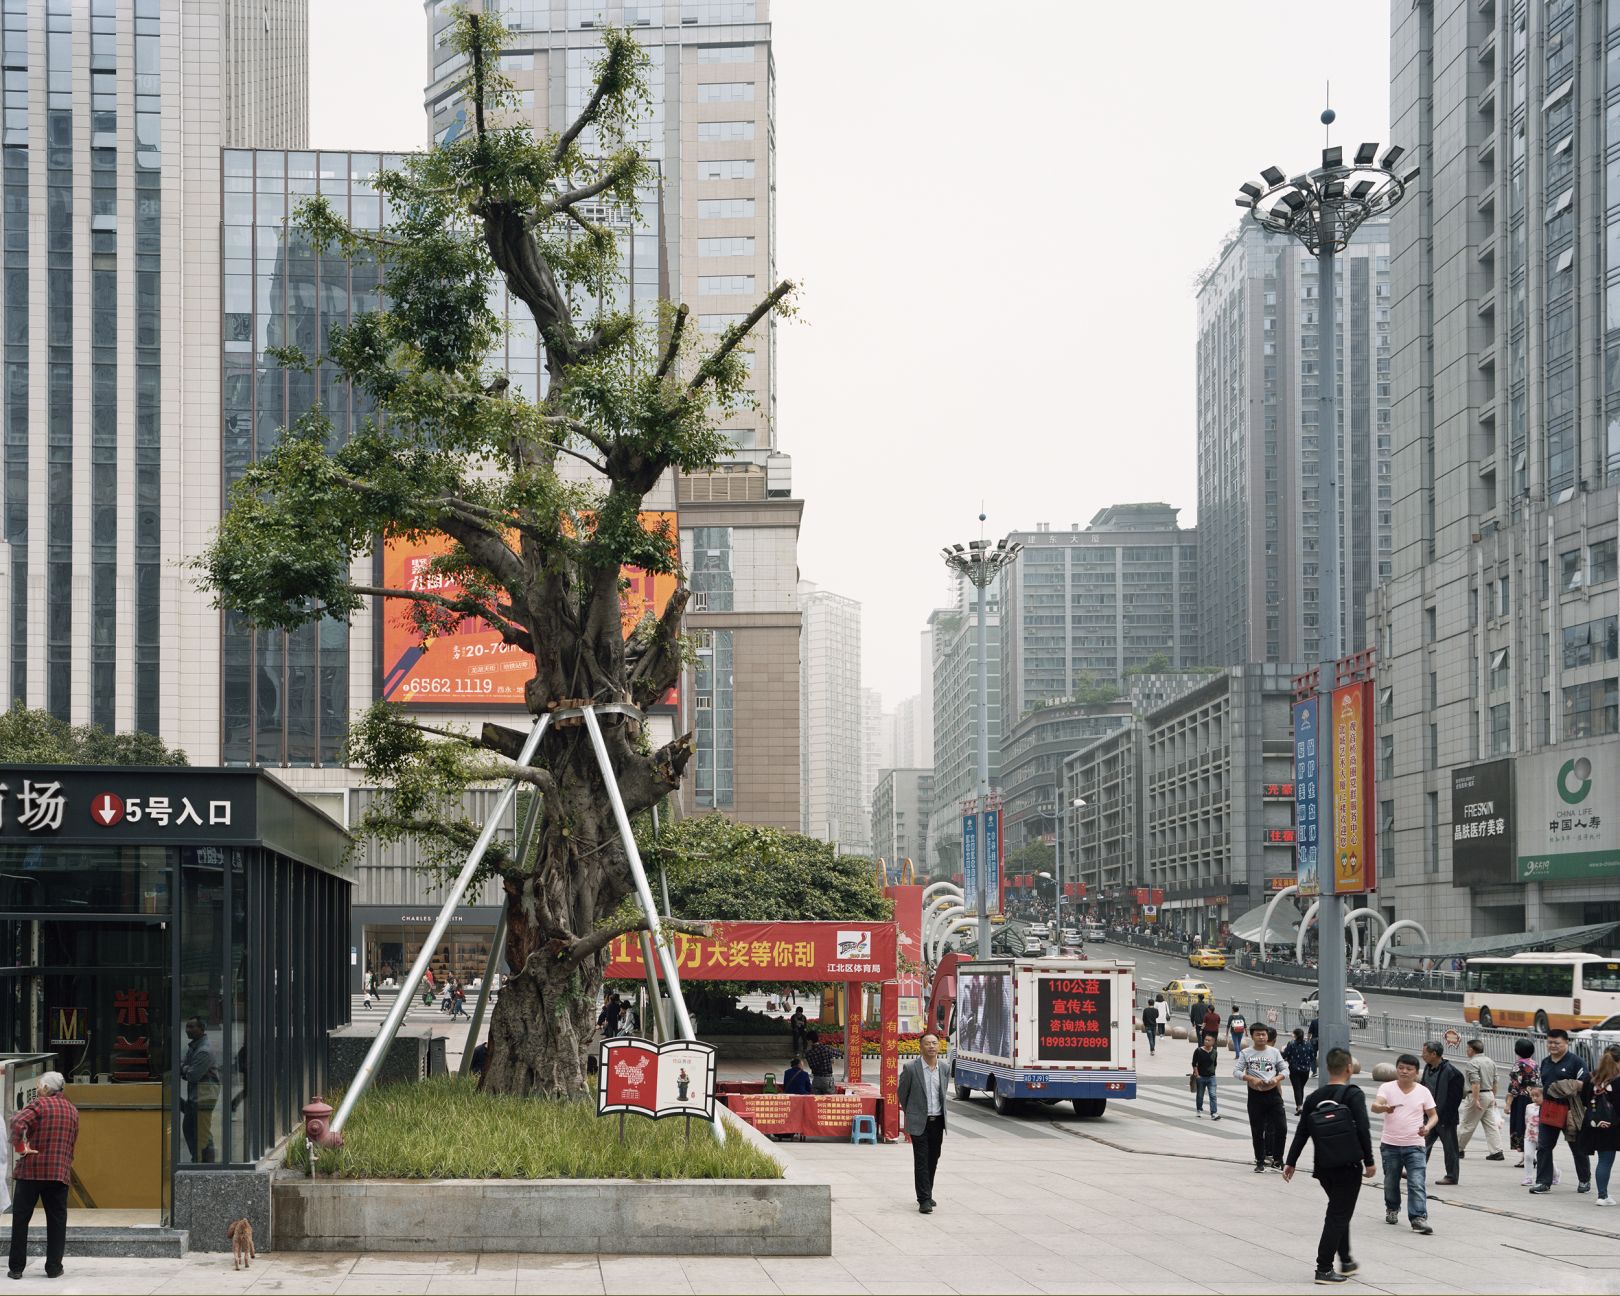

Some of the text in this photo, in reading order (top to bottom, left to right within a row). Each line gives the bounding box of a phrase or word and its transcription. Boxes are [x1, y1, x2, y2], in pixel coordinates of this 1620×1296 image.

[410, 678, 493, 693] 6562 1119
[0, 779, 66, 831] 场
[125, 796, 232, 826] 5号入口
[1464, 801, 1494, 818] FRESKIN
[1556, 807, 1593, 818] CHINA LIFE
[1454, 817, 1505, 841] 晶肤医疗美容
[1549, 815, 1601, 833] 中国人寿
[826, 963, 881, 973] 江北区体育局
[1048, 979, 1100, 994] 110公益
[1052, 999, 1097, 1014] 宣传车
[1050, 1020, 1099, 1032] 咨询热线
[1040, 1036, 1109, 1048] 18983378898
[886, 1020, 898, 1105] 有梦就来刮
